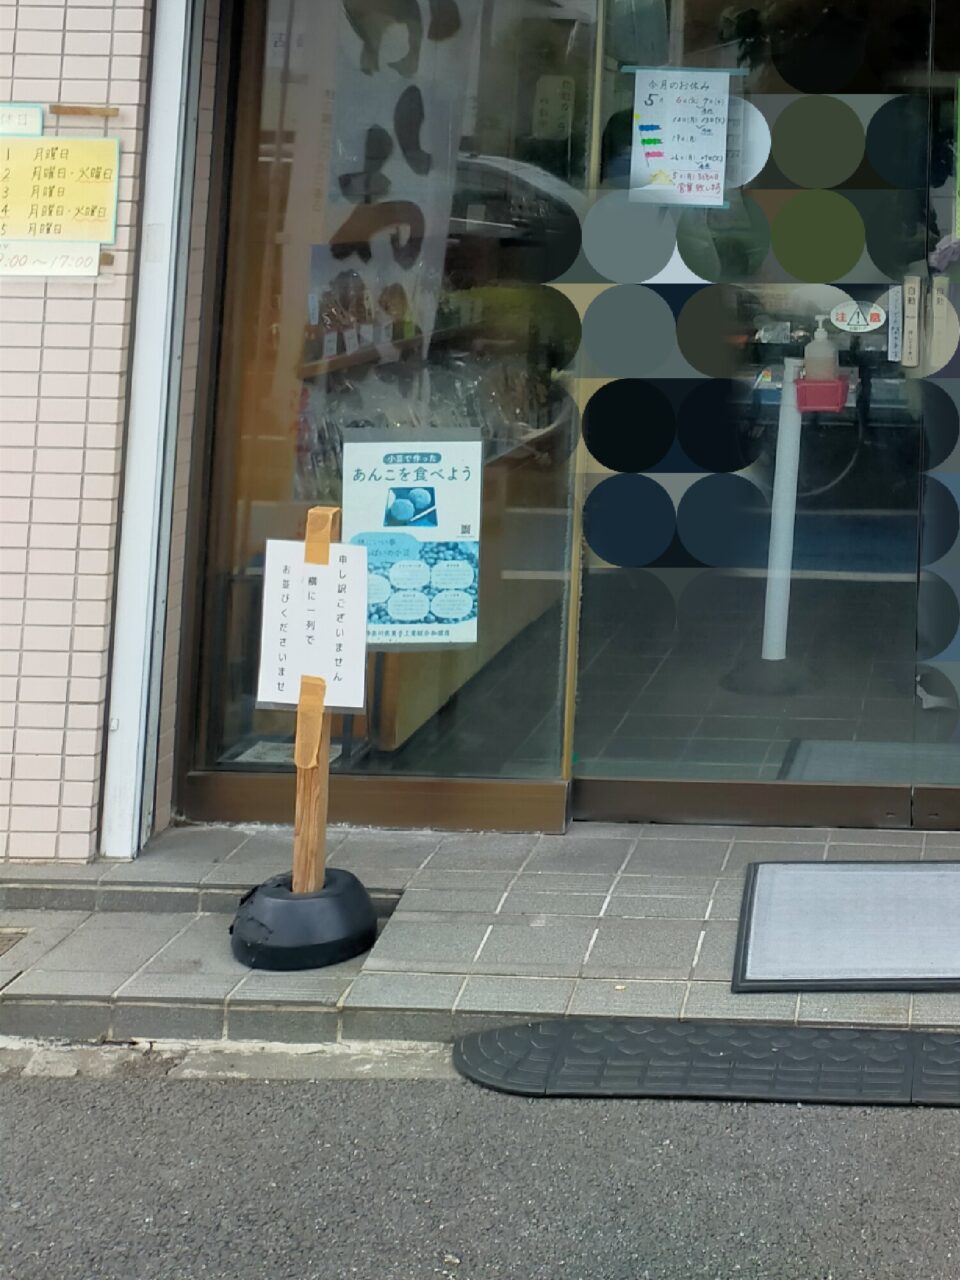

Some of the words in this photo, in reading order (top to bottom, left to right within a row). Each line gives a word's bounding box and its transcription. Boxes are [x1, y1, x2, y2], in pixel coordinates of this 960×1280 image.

[32, 147, 70, 161] 月曜日
[30, 184, 66, 199] 月曜日
[28, 223, 62, 237] 月曜日
[352, 466, 473, 483] あんこを食べよう
[305, 576, 318, 645] 横に一列で
[332, 554, 349, 682] 申し訳ございません
[276, 564, 291, 692] お並びくださいませ
